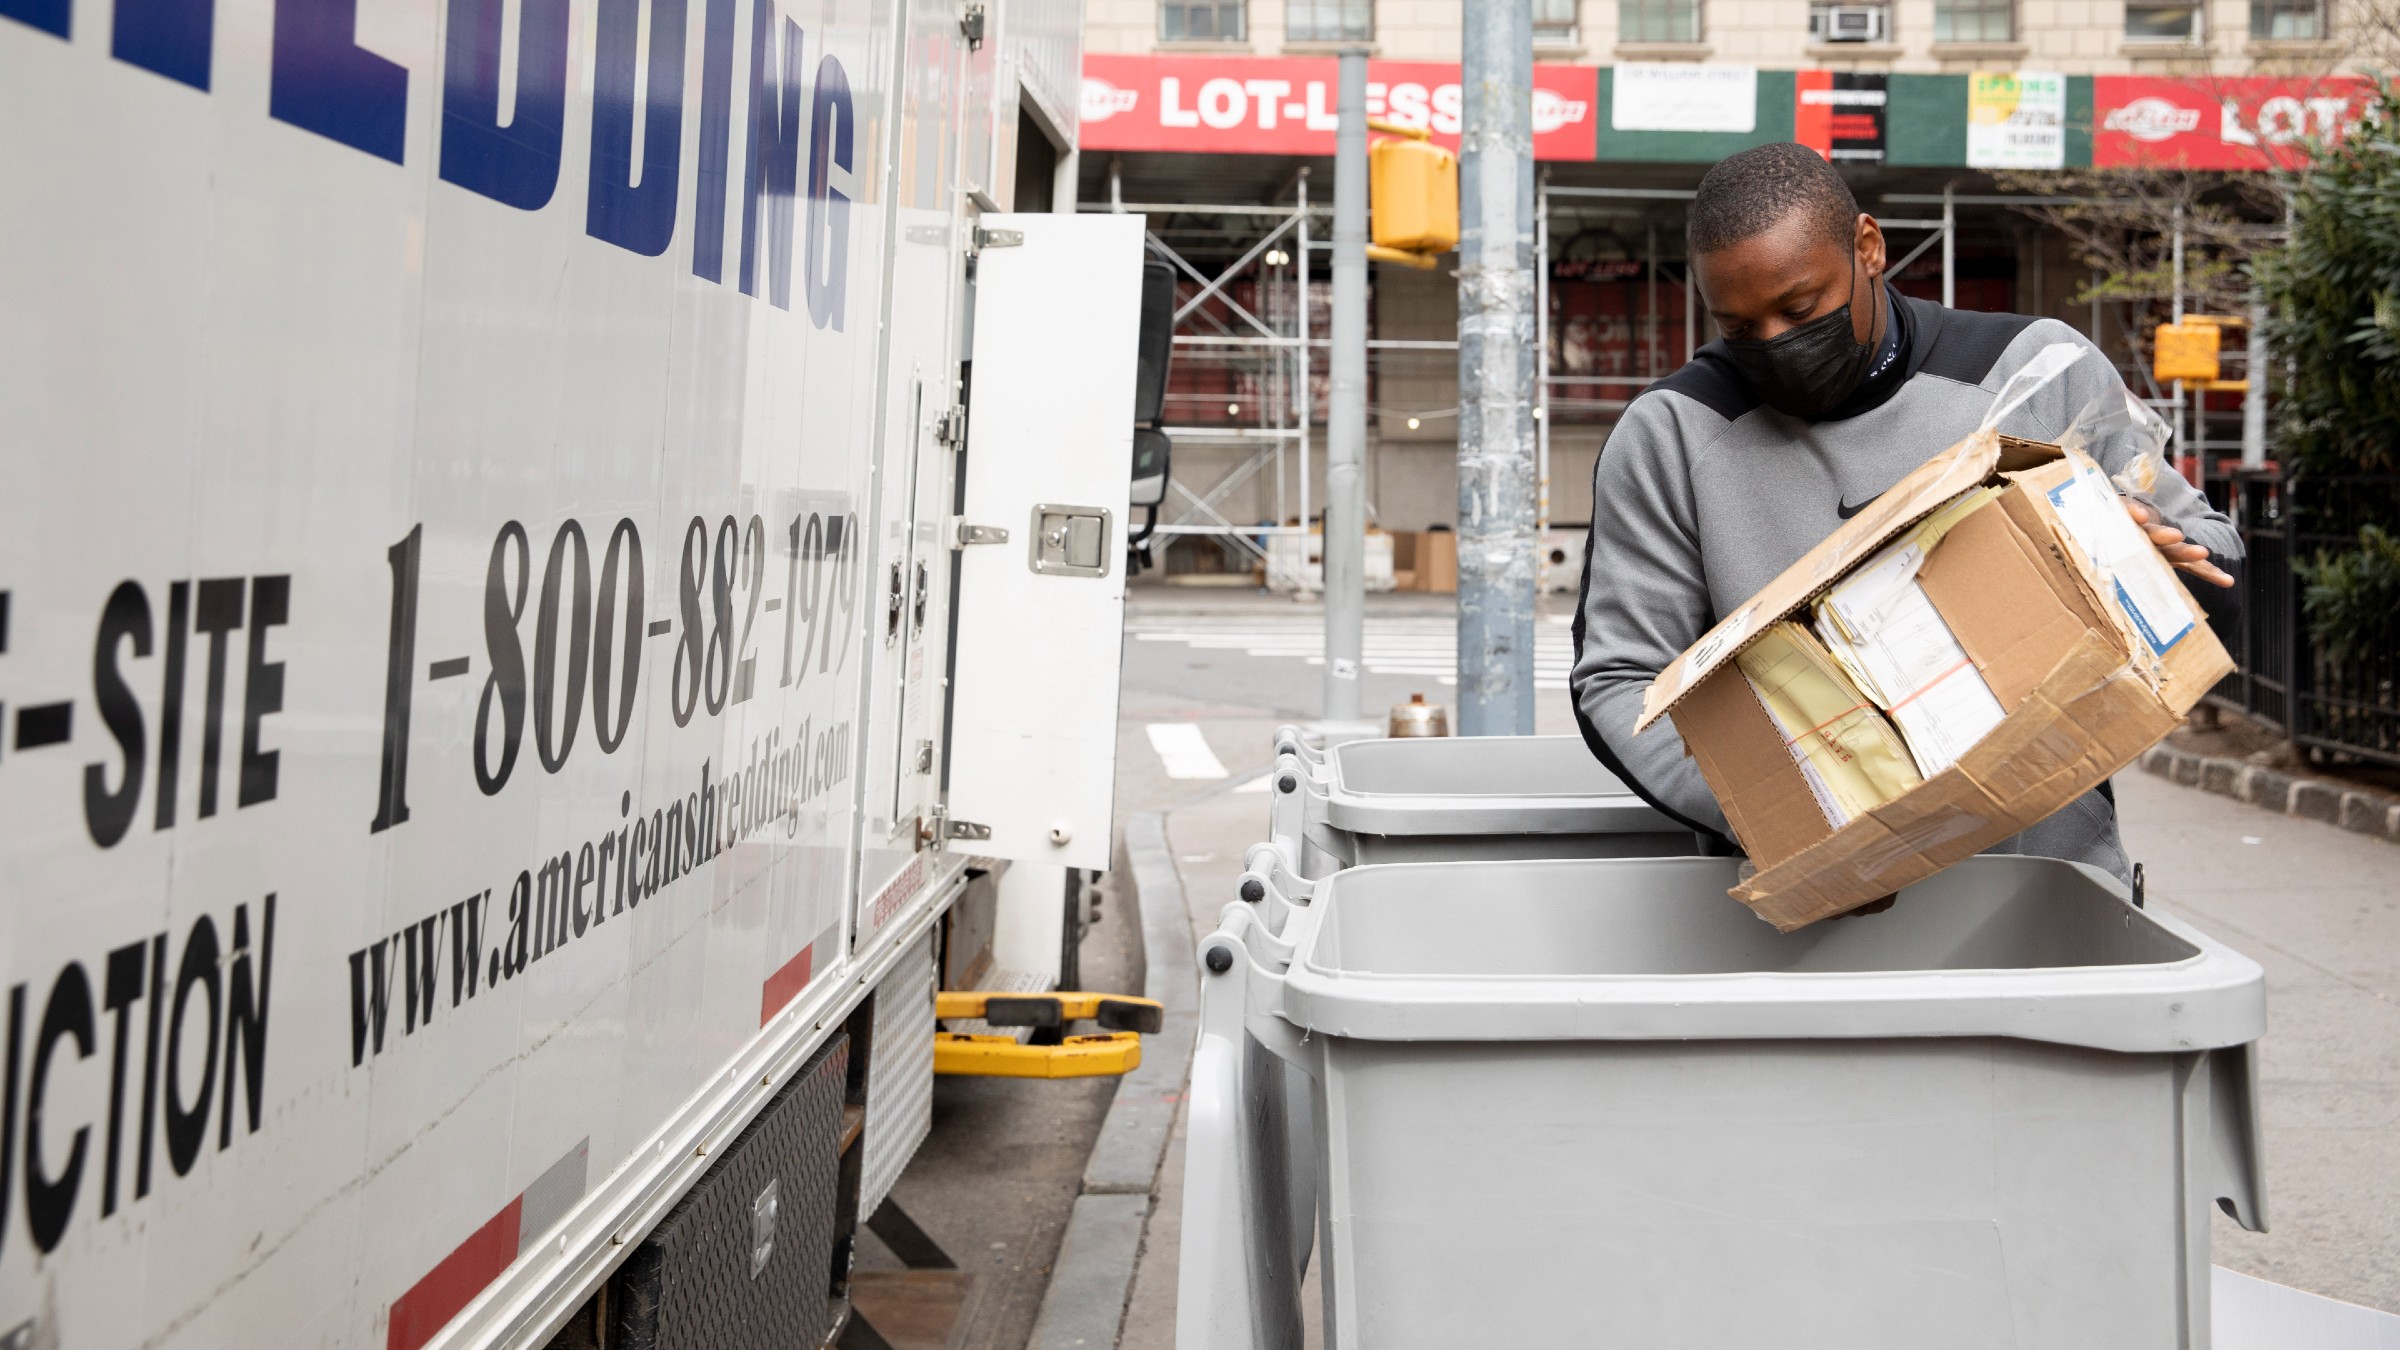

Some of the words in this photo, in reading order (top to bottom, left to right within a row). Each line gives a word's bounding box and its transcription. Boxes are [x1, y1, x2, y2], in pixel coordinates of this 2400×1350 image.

[0, 574, 291, 849] -SITE
[370, 512, 858, 834] 1-800-882-1979
[0, 892, 276, 1268] CTION
